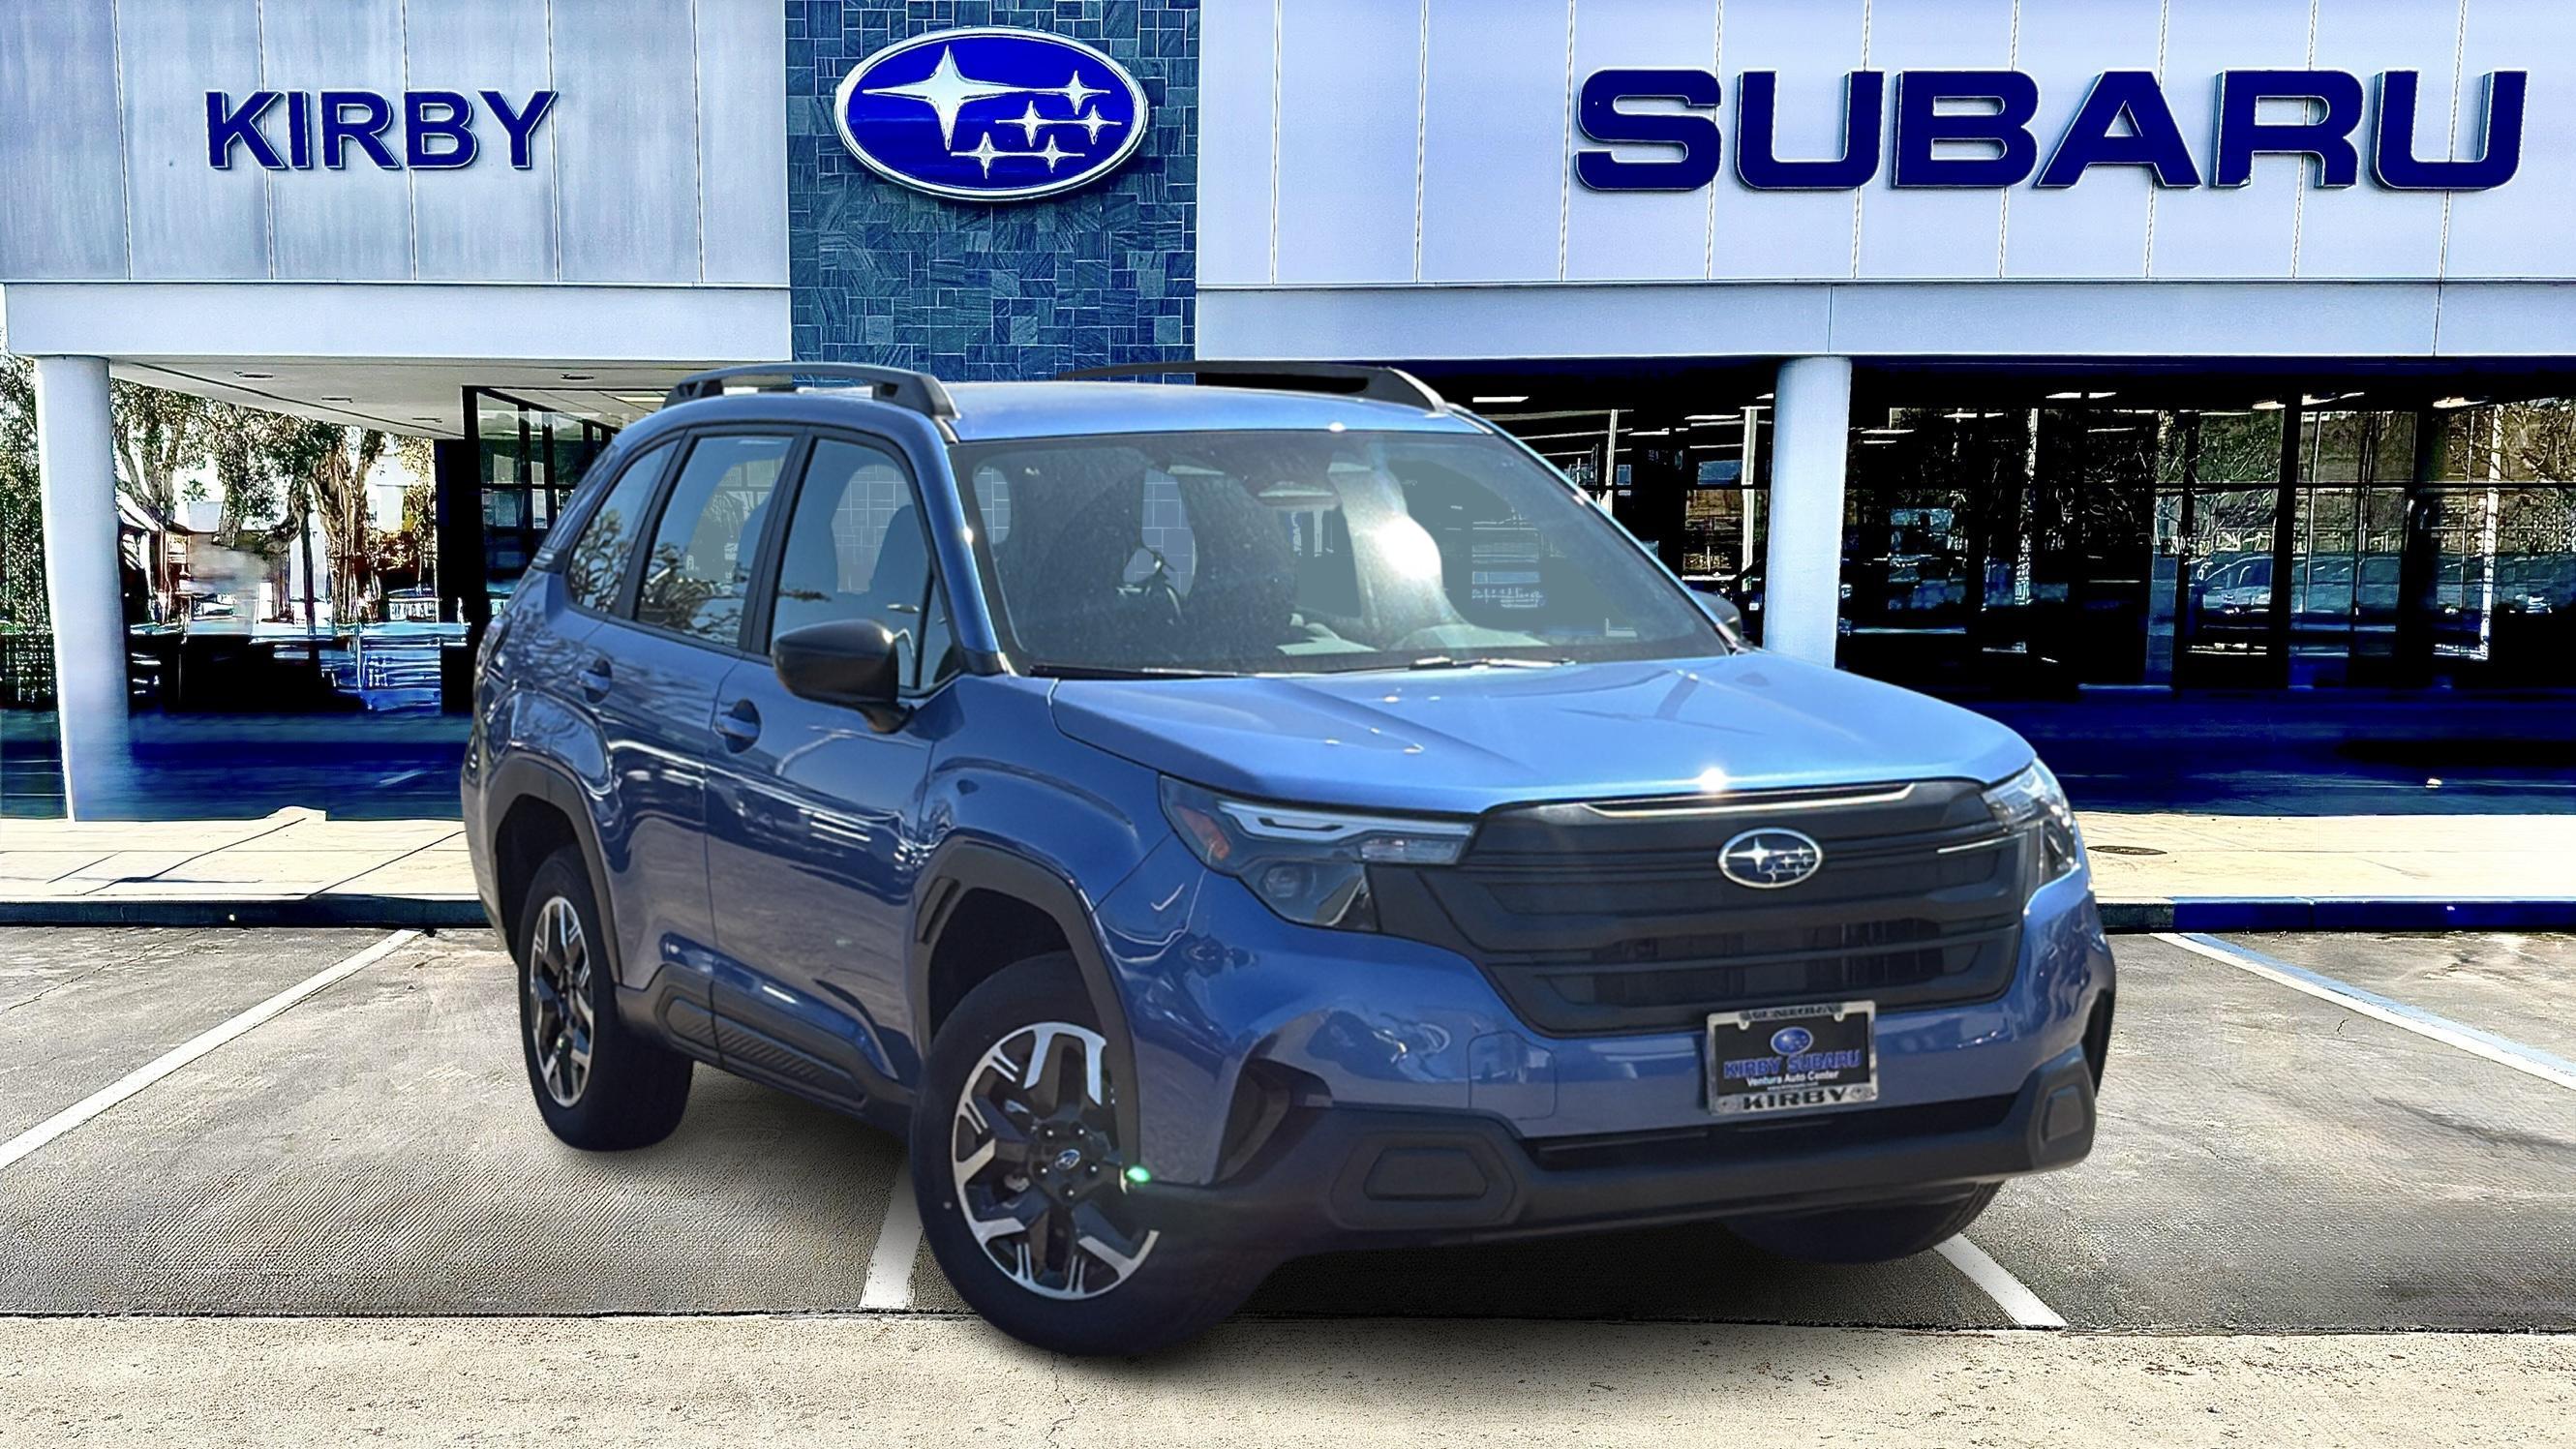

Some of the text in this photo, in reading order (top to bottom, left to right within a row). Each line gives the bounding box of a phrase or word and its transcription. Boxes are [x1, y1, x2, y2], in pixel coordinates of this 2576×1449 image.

[204, 90, 560, 170] KIRBY
[1574, 69, 2528, 191] SUBARU
[1724, 1049, 1861, 1079] KIRBY SUBARU
[1746, 1075, 1782, 1087] Ventura
[1784, 1072, 1806, 1083] Auto
[1807, 1070, 1840, 1081] Center
[1743, 1087, 1847, 1109] KIRBY
